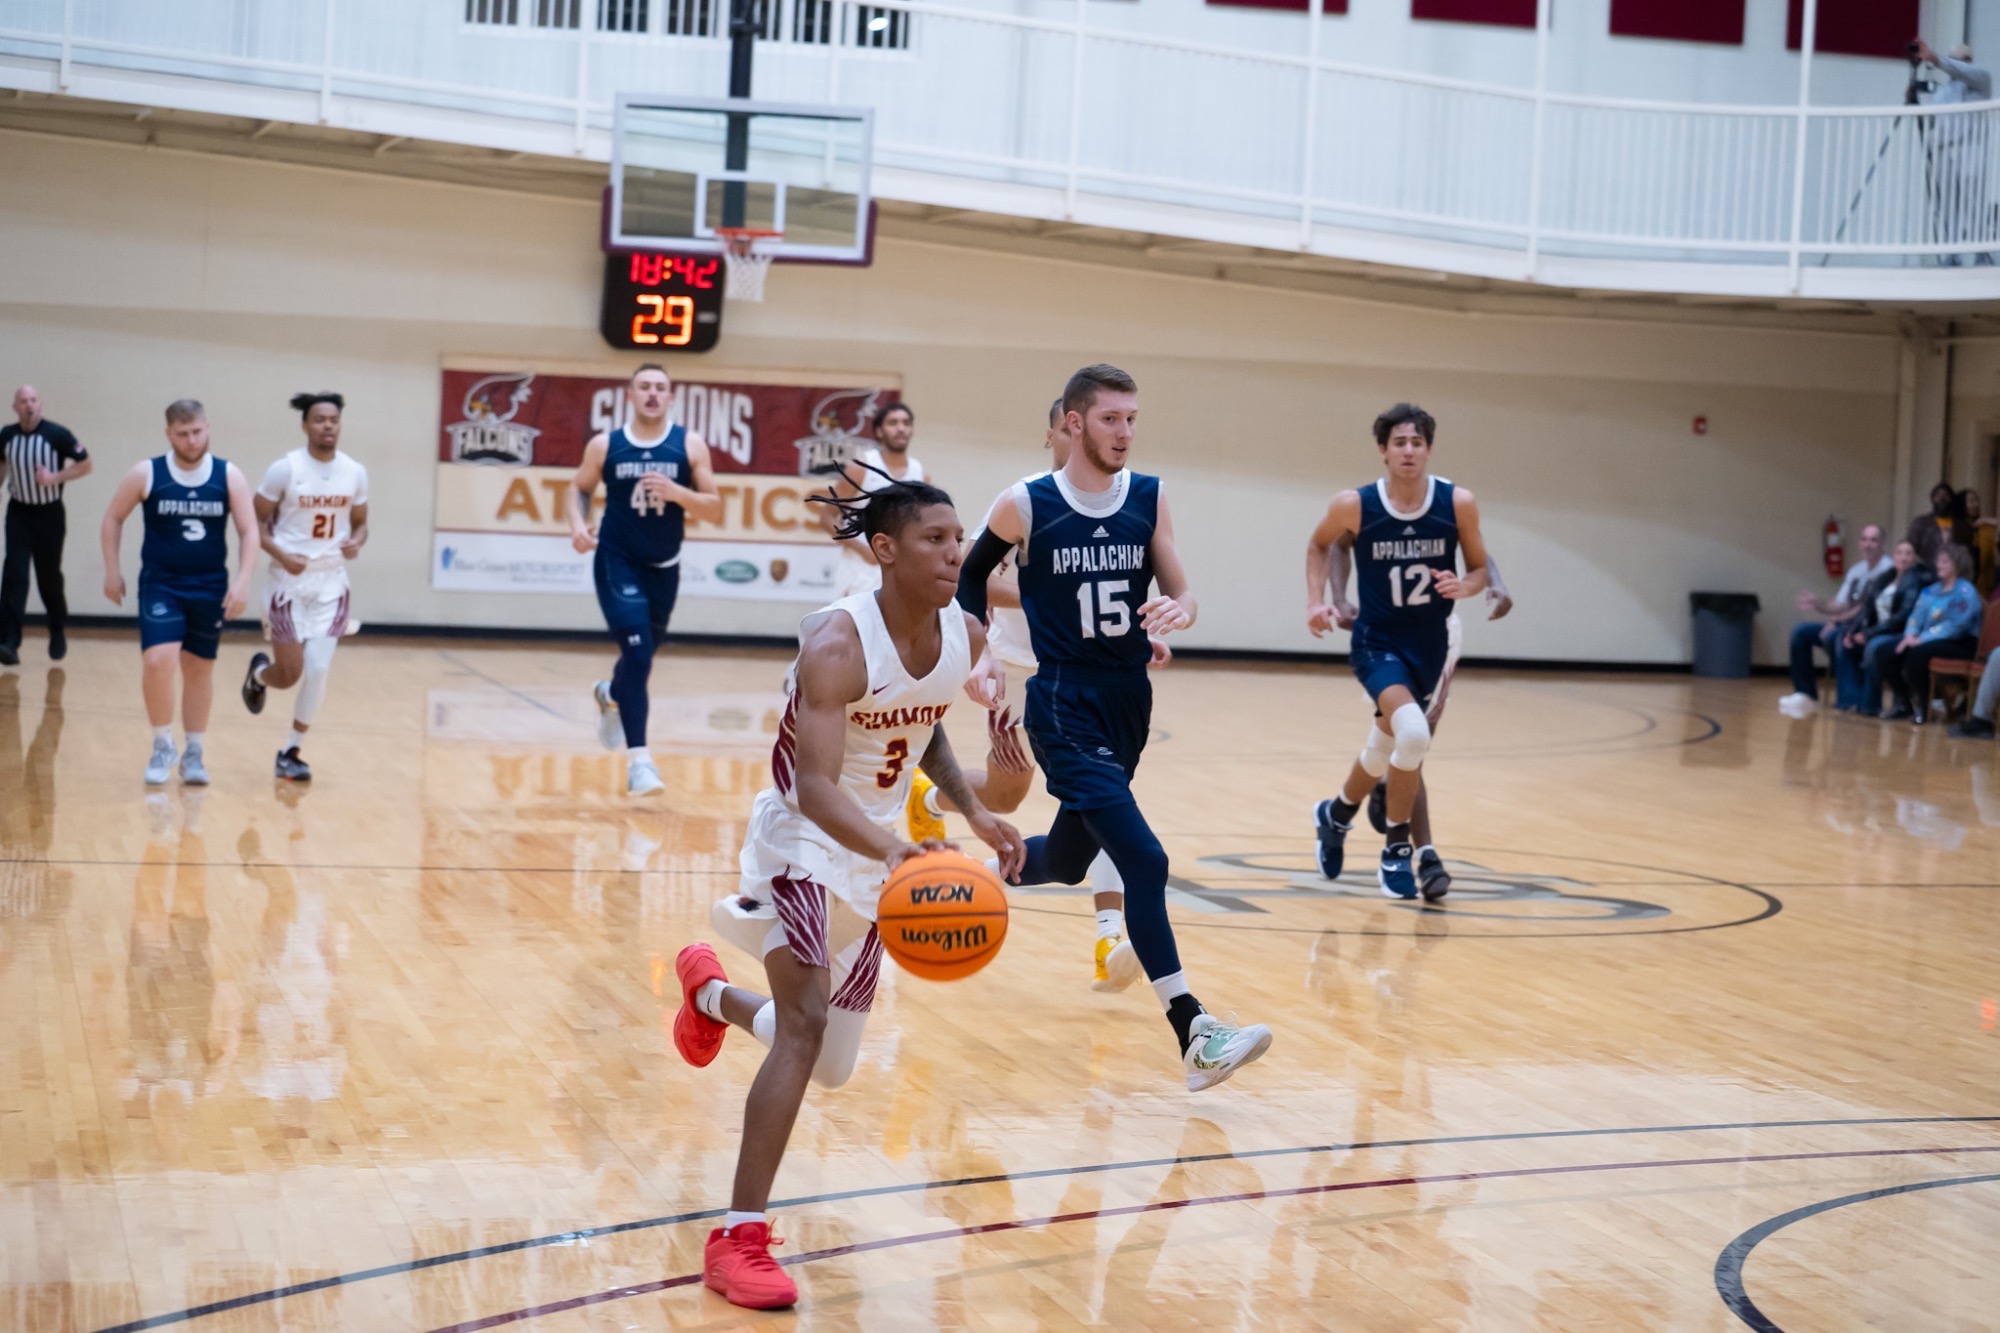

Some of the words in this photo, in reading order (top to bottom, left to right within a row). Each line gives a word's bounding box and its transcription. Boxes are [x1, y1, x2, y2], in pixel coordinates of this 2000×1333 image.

[630, 253, 718, 289] 18:42
[631, 294, 694, 346] 29
[496, 477, 844, 532] ATTICS
[630, 481, 666, 517] 44
[181, 518, 206, 541] 3
[312, 513, 335, 539] 21
[1372, 538, 1446, 560] APPALACHIAN
[1388, 563, 1431, 608] 12
[1076, 580, 1131, 639] 15
[850, 703, 952, 731] SIMMON
[876, 737, 909, 789] 3
[910, 883, 974, 905] NCAA
[901, 923, 988, 951] Wilson
